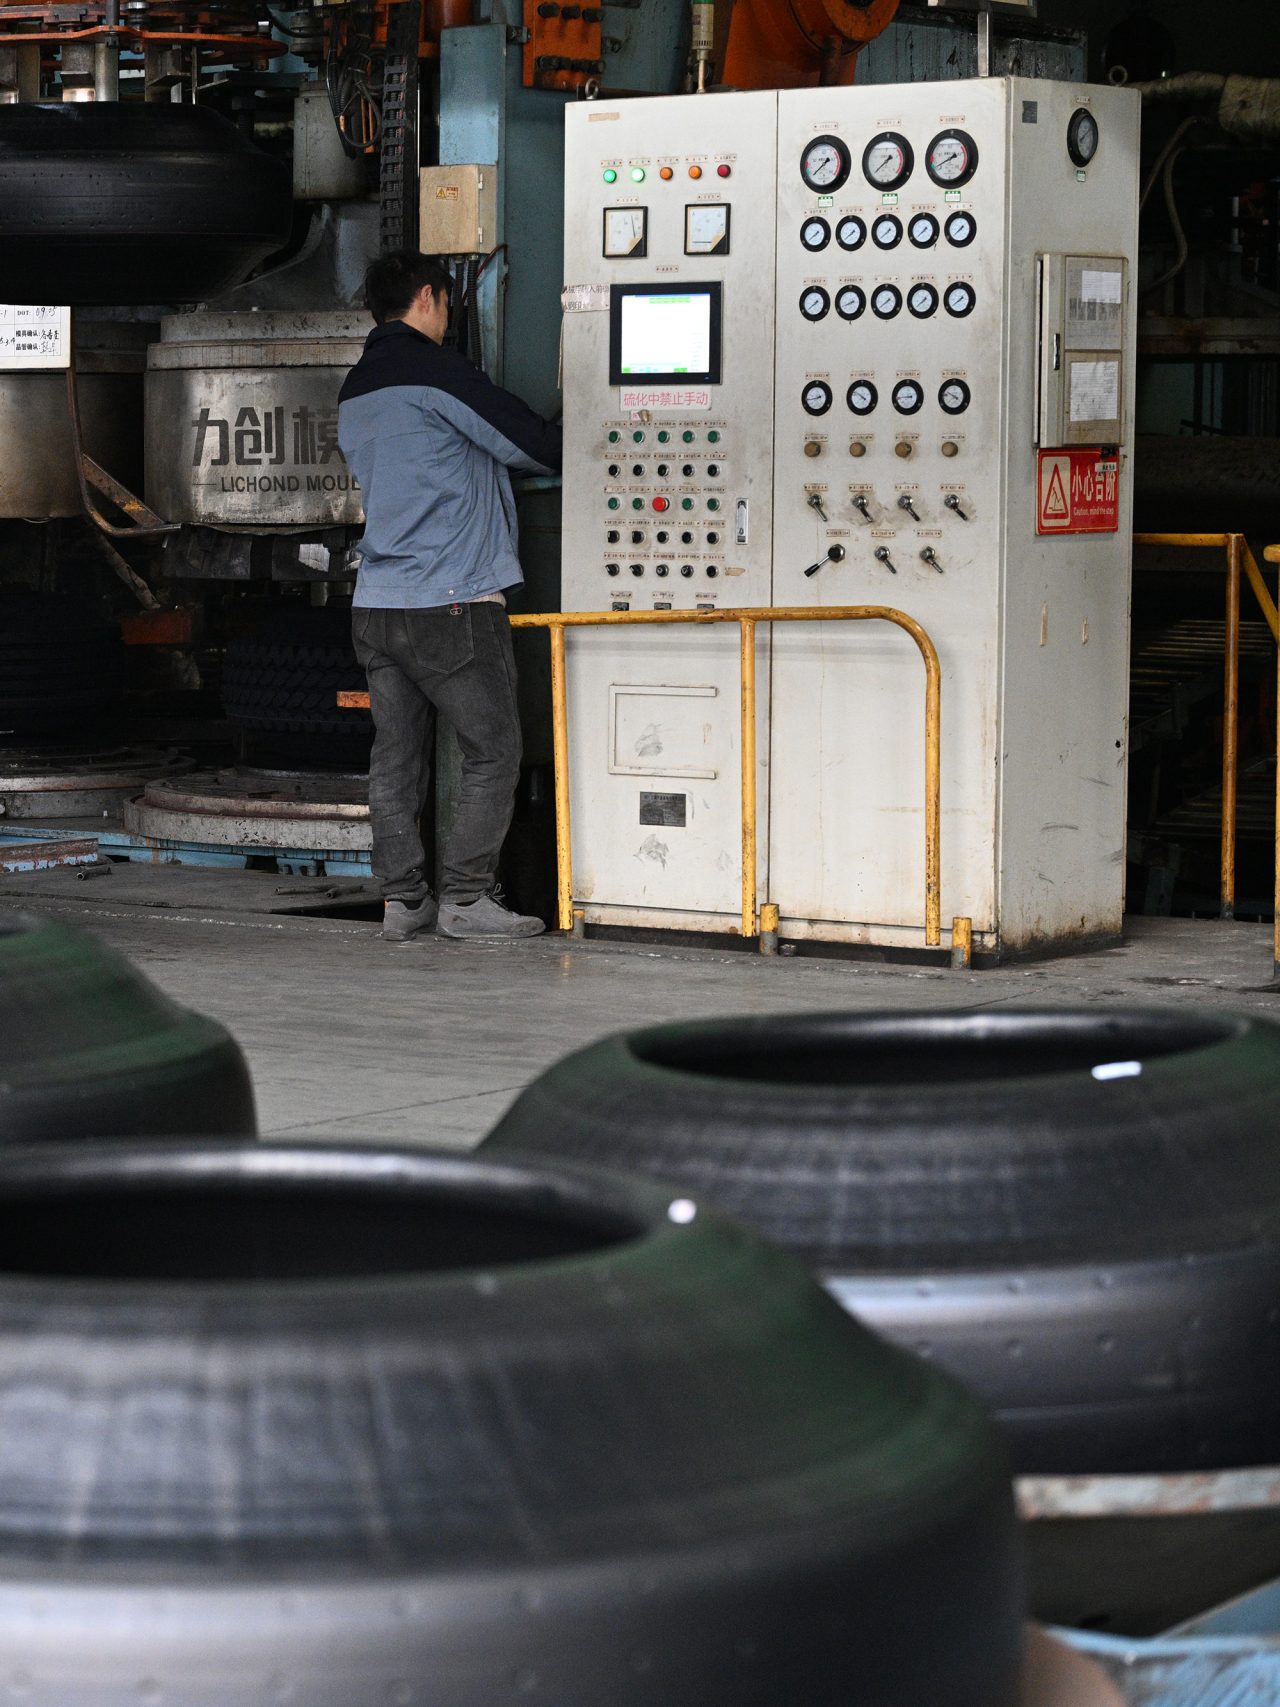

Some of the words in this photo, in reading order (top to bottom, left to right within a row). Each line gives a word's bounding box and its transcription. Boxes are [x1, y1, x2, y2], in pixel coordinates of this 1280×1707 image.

[623, 391, 709, 406] 硫化中禁止手动
[221, 475, 300, 493] LICHOND
